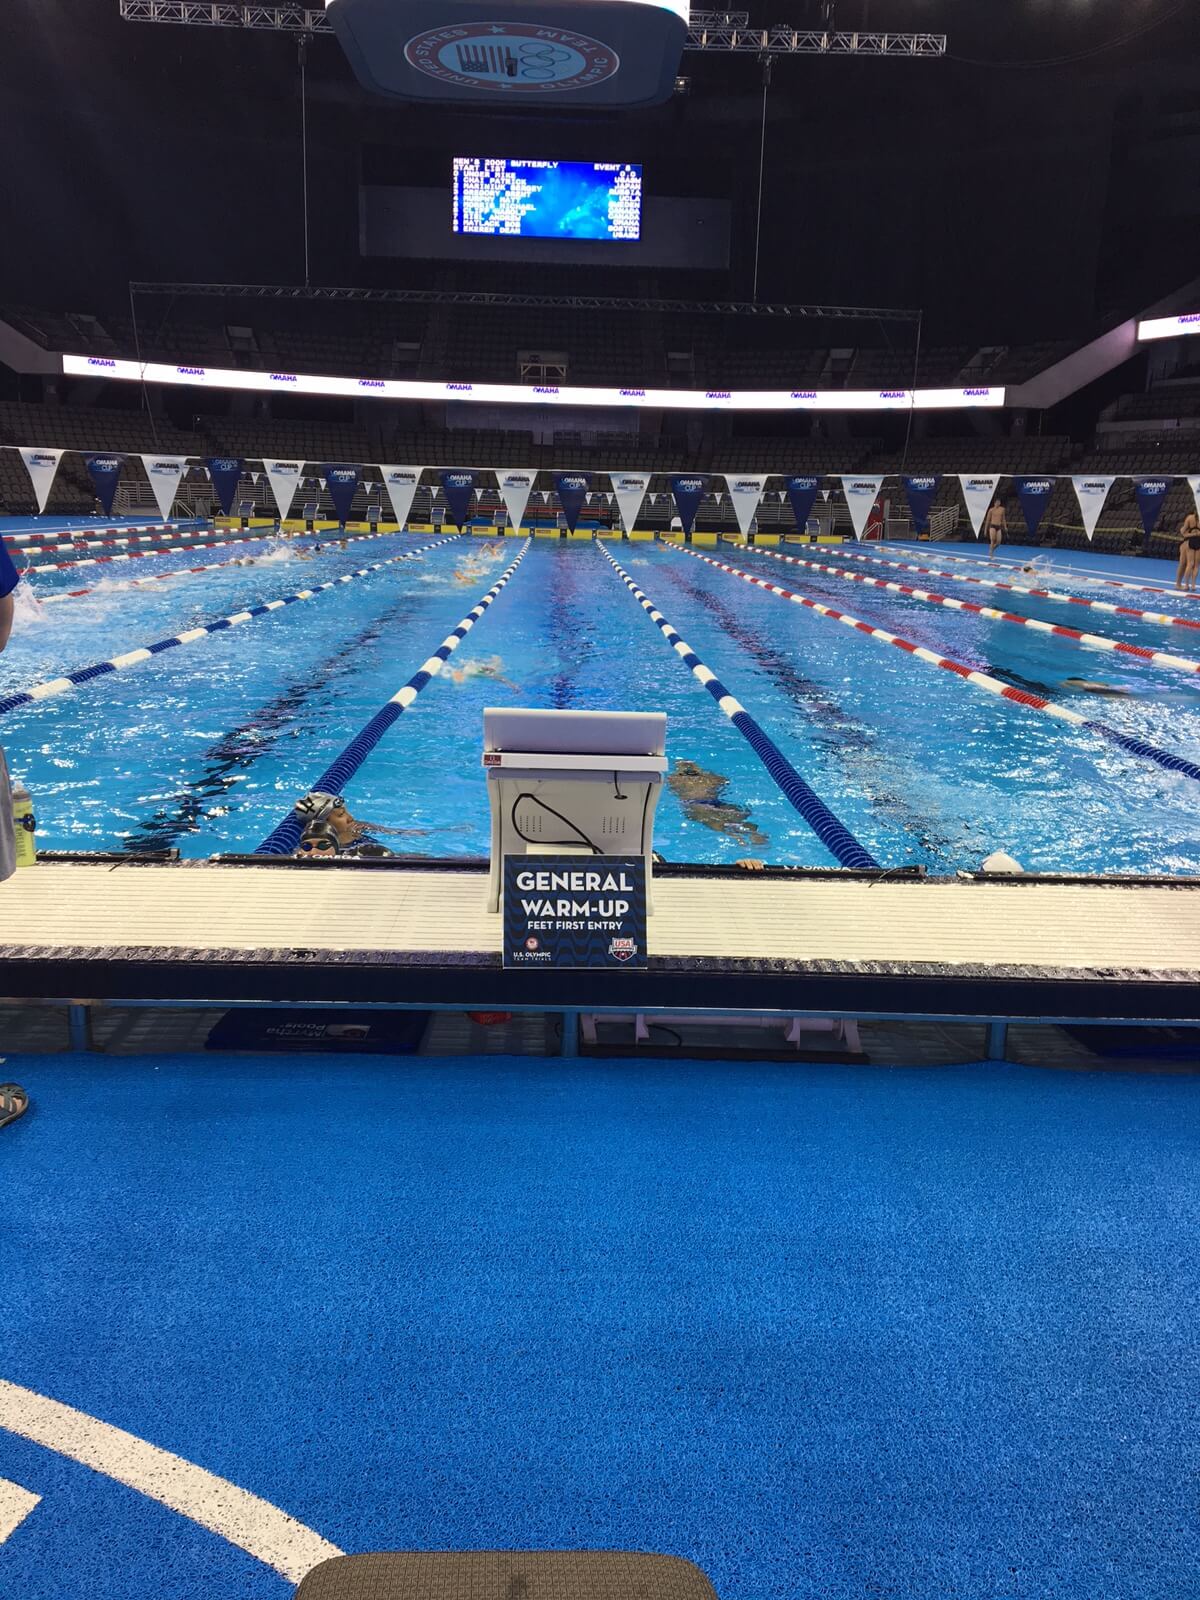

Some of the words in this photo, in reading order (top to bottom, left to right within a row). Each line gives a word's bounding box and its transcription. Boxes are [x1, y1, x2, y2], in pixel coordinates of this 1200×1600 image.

[415, 28, 468, 56] STATES
[536, 29, 598, 53] TEAM
[418, 58, 479, 85] UNITED
[540, 57, 609, 89] OLYMPIC
[511, 160, 558, 168] BUTTERFLY
[594, 163, 620, 171] EVENT
[88, 358, 116, 368] OMAHA
[176, 367, 205, 376] OMAHA
[269, 374, 298, 382] OMAHA
[358, 379, 386, 388] OMAHA
[446, 383, 473, 391] OMAHA
[532, 386, 560, 394] OMAHA
[619, 389, 646, 397] OMAHA
[963, 388, 990, 396] OMAHA
[705, 391, 732, 399] OMAHA
[790, 391, 818, 399] OMAHA
[879, 391, 906, 399] OMAHA
[516, 871, 634, 891] GENERAL
[520, 899, 630, 917] WARM-UP
[527, 920, 554, 930] FEET
[555, 920, 585, 930] FIRST
[587, 920, 623, 930] ENTRY
